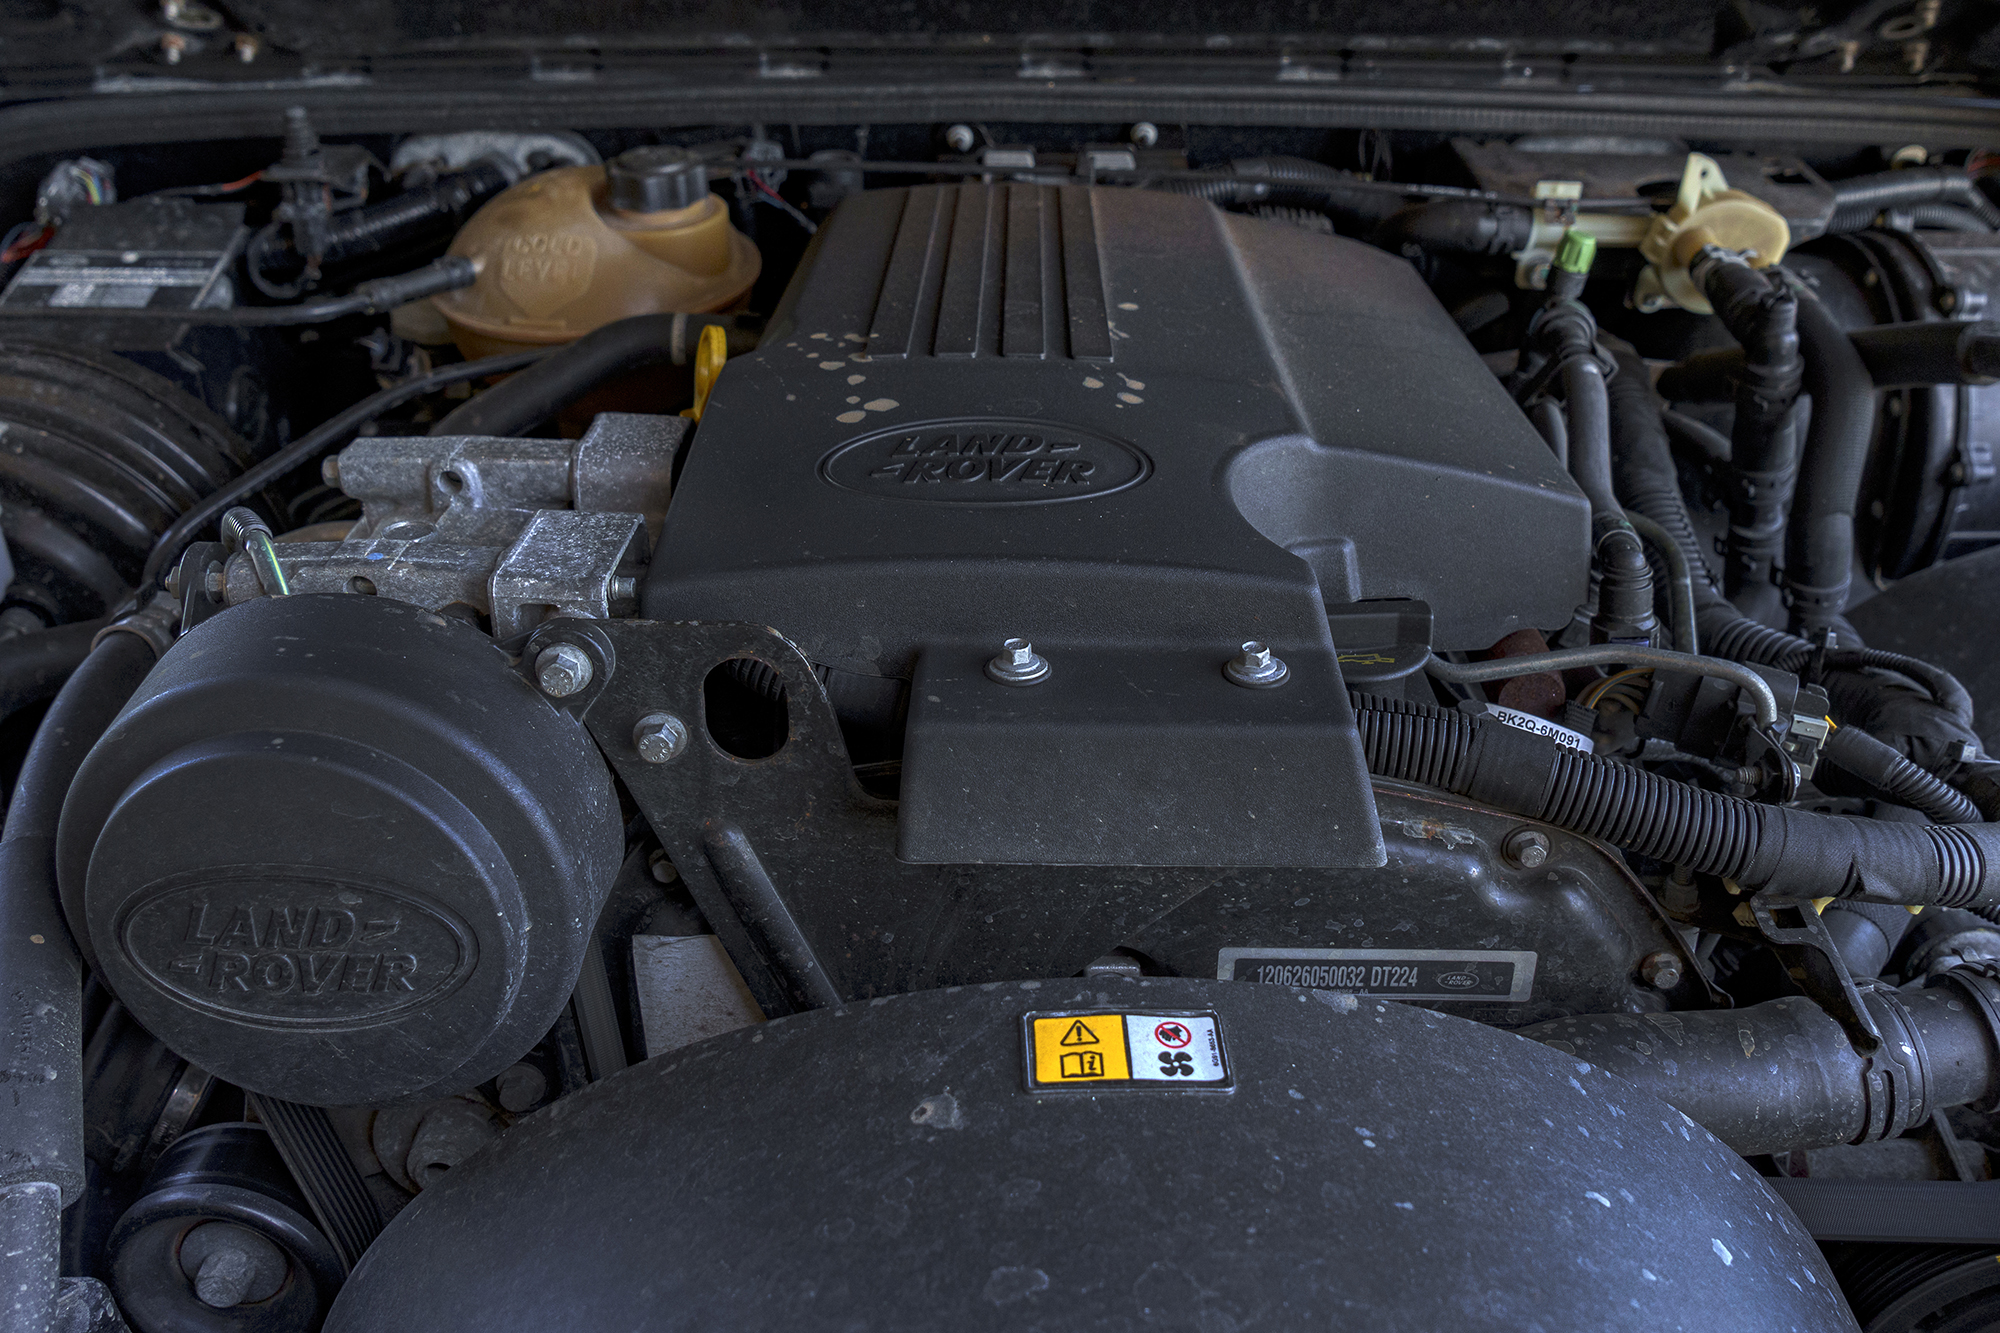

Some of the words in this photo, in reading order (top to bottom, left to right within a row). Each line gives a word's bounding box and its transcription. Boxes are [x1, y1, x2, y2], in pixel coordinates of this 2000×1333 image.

[890, 433, 1046, 458] LAND
[901, 457, 1097, 485] ROVER
[1496, 710, 1581, 749] BK2Q-6M091
[184, 903, 357, 950] LAND
[207, 952, 418, 996] ROVER
[1256, 964, 1366, 987] 120626050032
[1370, 965, 1419, 988] DT224
